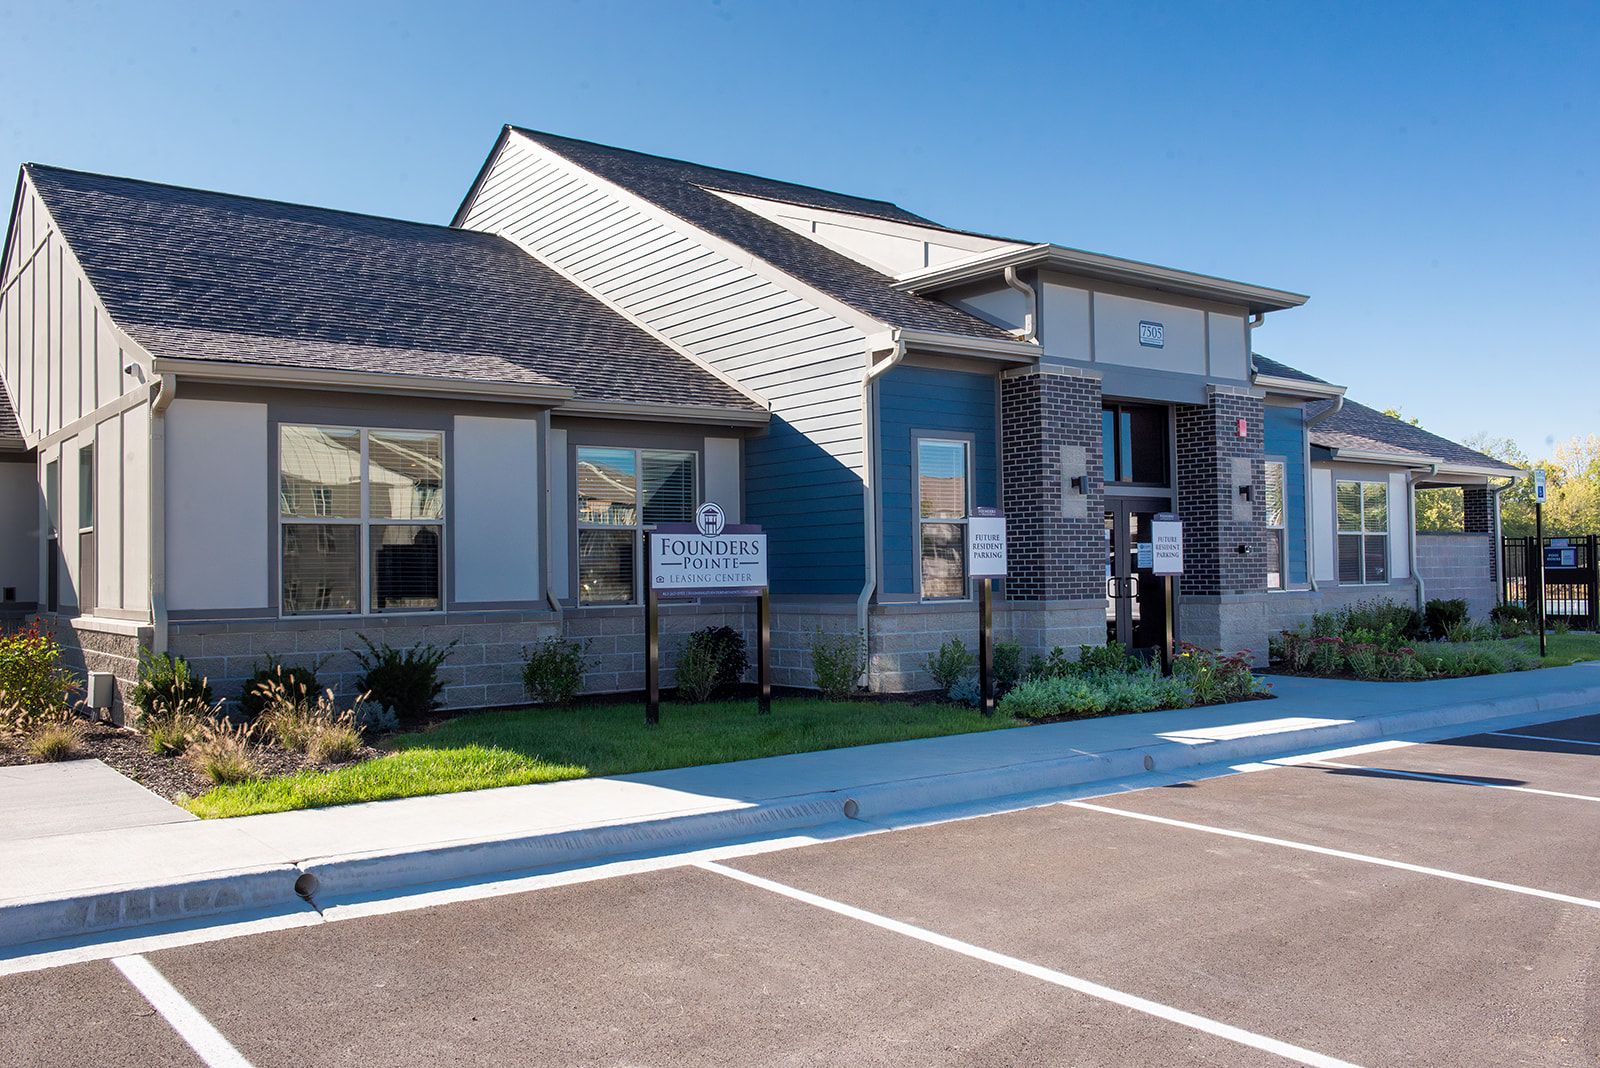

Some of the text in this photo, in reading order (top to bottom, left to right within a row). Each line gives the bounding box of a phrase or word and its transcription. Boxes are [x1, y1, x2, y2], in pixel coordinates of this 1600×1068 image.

[1142, 325, 1161, 339] 7505
[661, 538, 759, 555] FOUNDERS
[683, 557, 740, 569] POINTE
[670, 573, 752, 583] LEASING CENTER
